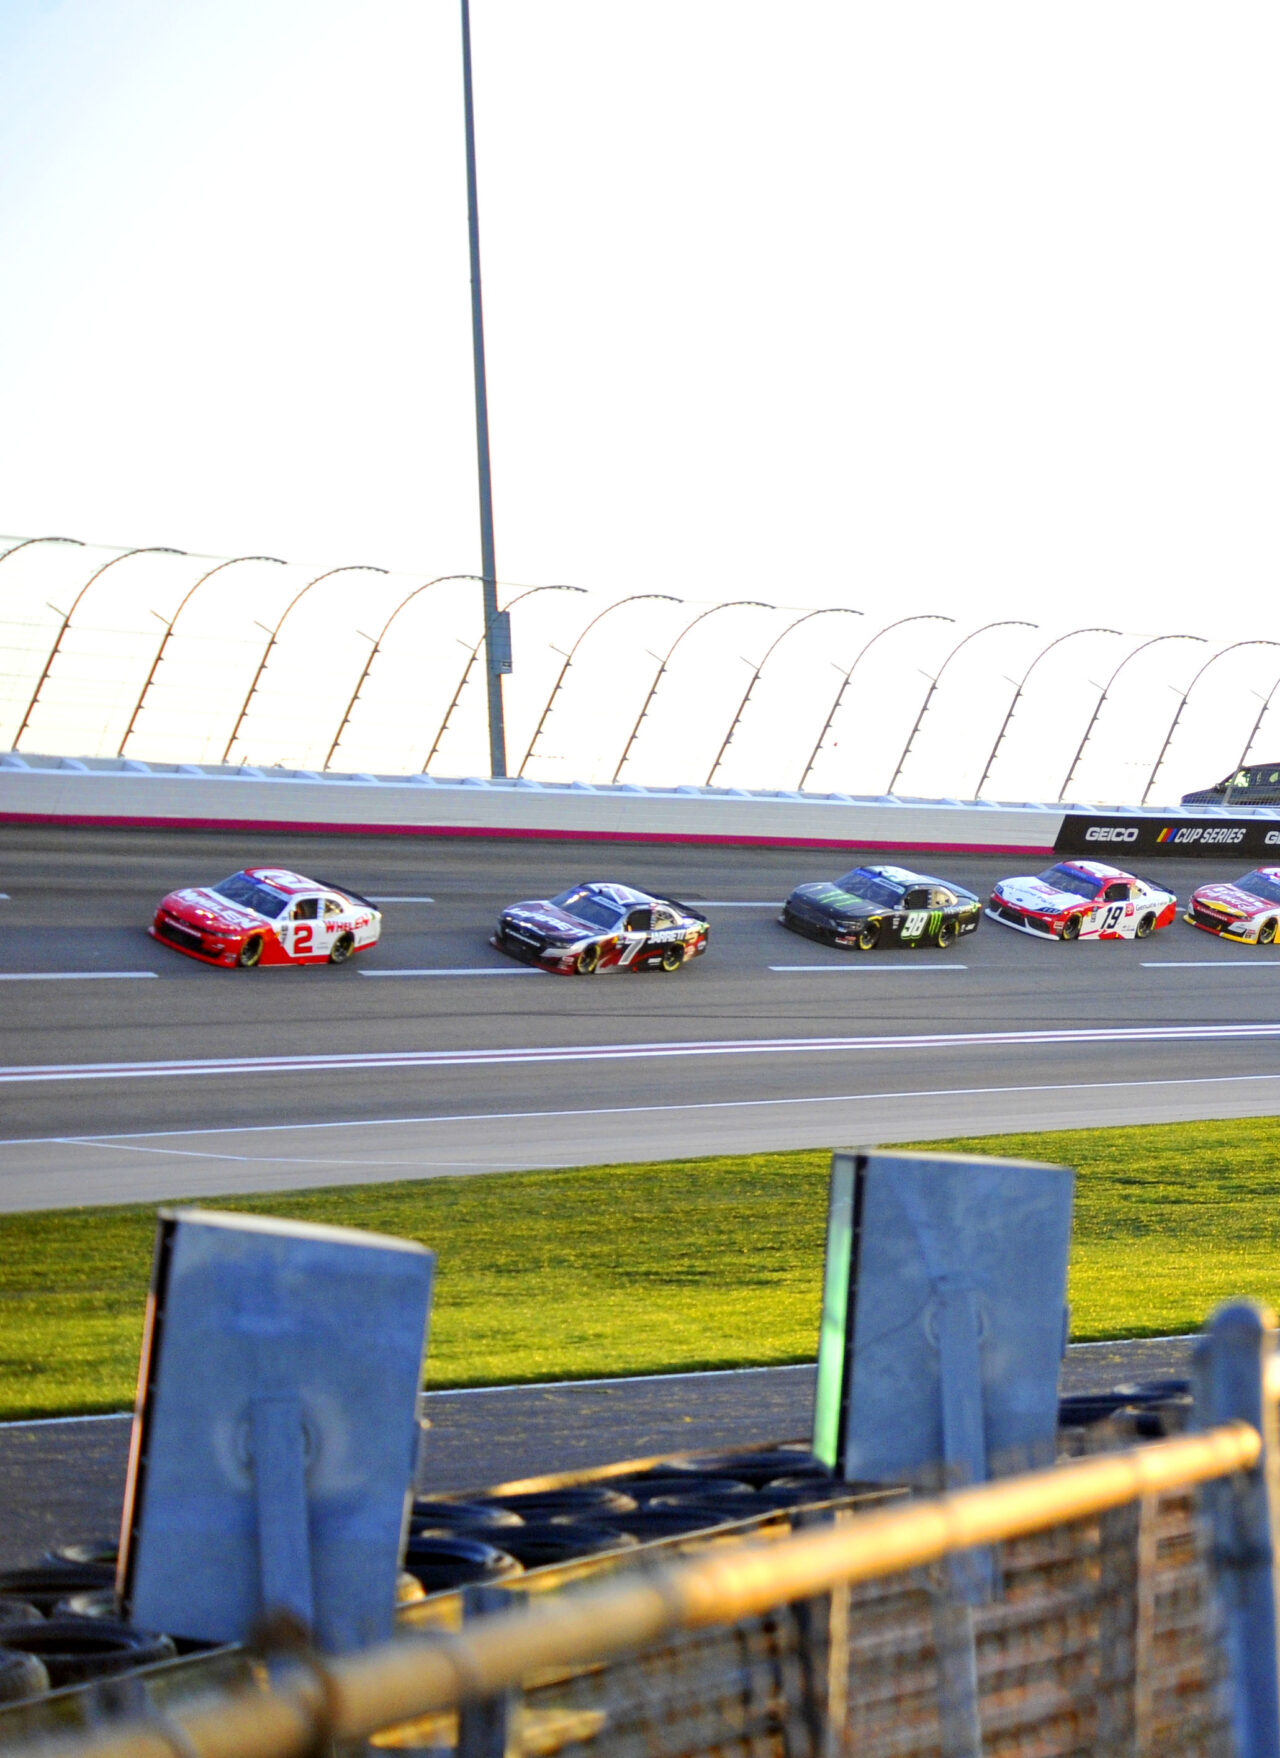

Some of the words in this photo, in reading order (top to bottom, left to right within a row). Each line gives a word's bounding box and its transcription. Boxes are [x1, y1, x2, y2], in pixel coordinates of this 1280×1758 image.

[1085, 827, 1139, 841] GEICO
[1174, 828, 1201, 843] CUP
[1200, 828, 1246, 843] SERIES
[323, 914, 370, 933] WHELEN
[901, 911, 928, 940] 98
[1100, 906, 1123, 929] 19
[294, 924, 313, 954] 2
[648, 929, 685, 944] JARRETT
[617, 932, 648, 965] 7
